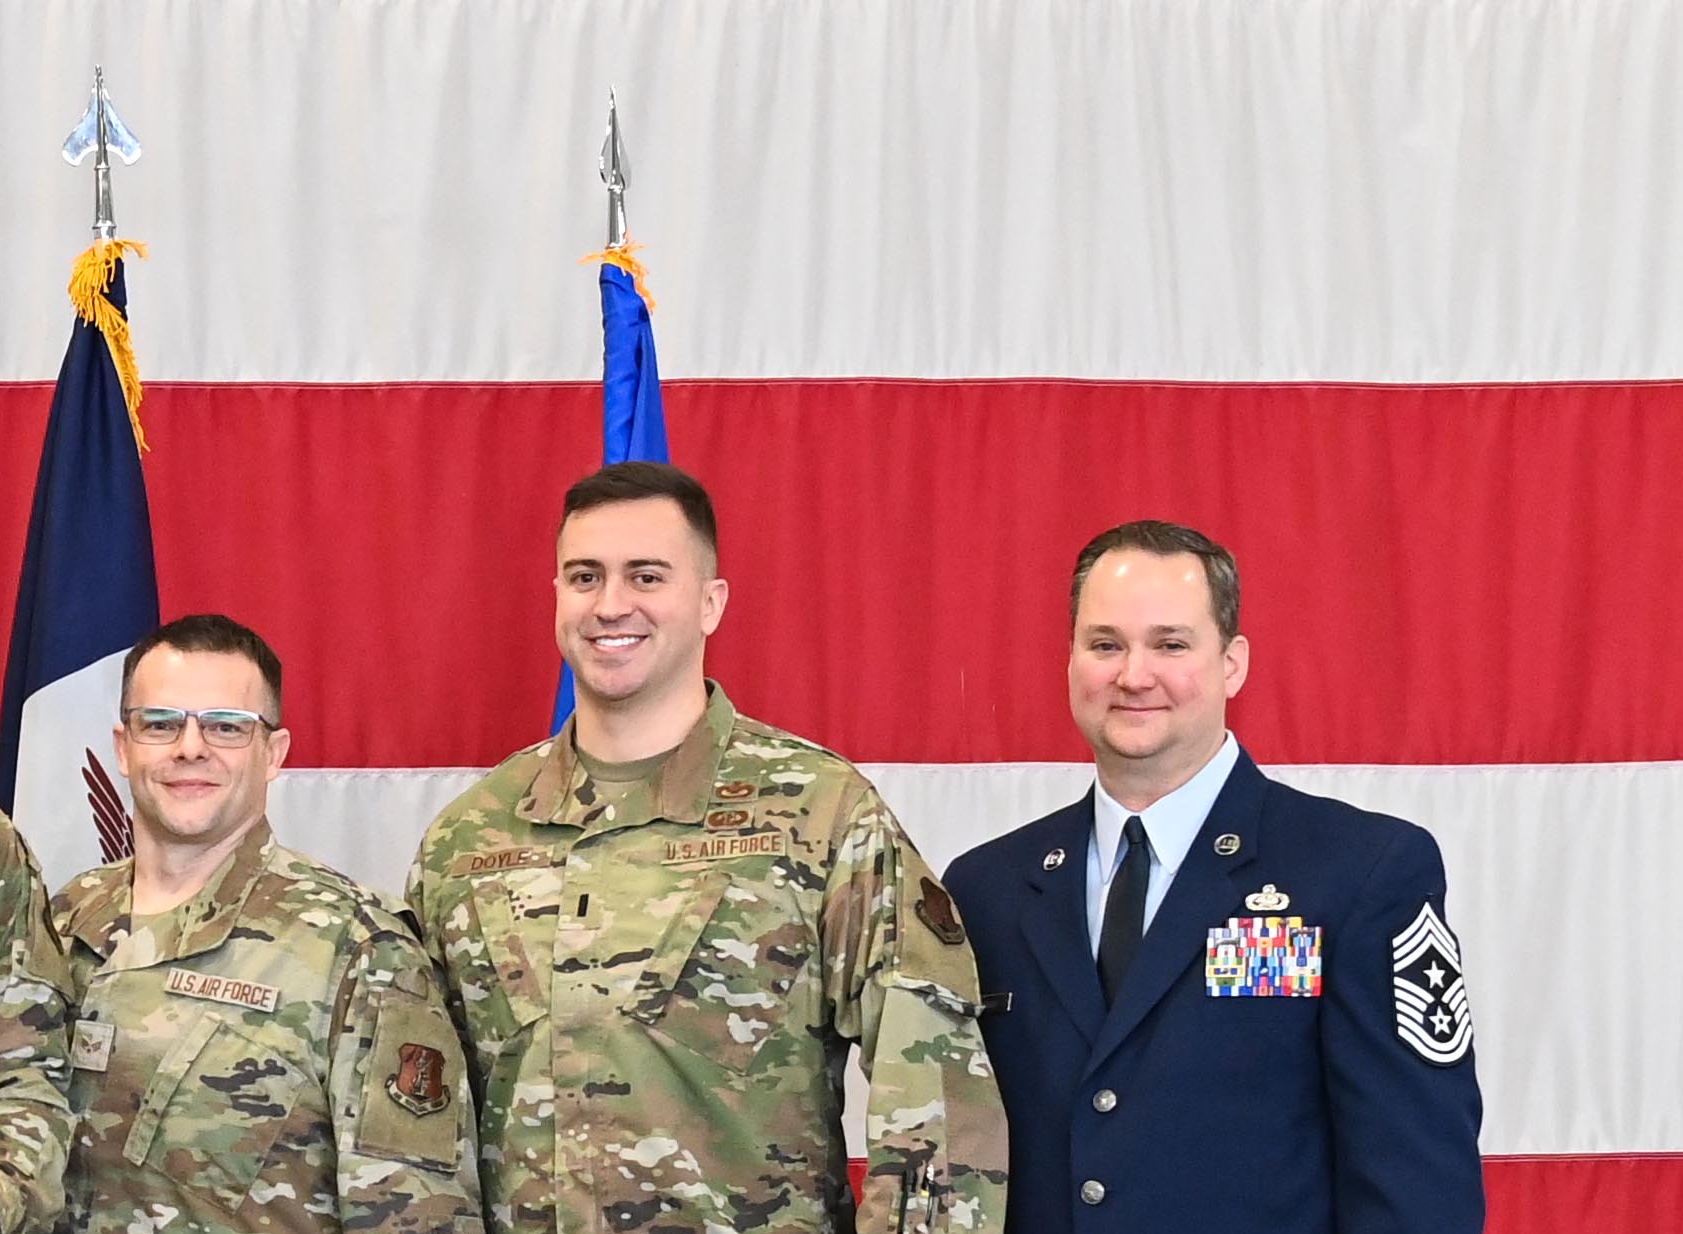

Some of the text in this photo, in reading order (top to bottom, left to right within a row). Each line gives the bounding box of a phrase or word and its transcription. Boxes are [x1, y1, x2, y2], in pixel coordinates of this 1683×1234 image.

[700, 839, 726, 857] AIR
[730, 835, 782, 854] FORCE
[471, 851, 530, 870] DOYLE
[171, 971, 273, 1008] U.S. AIR FORCE
